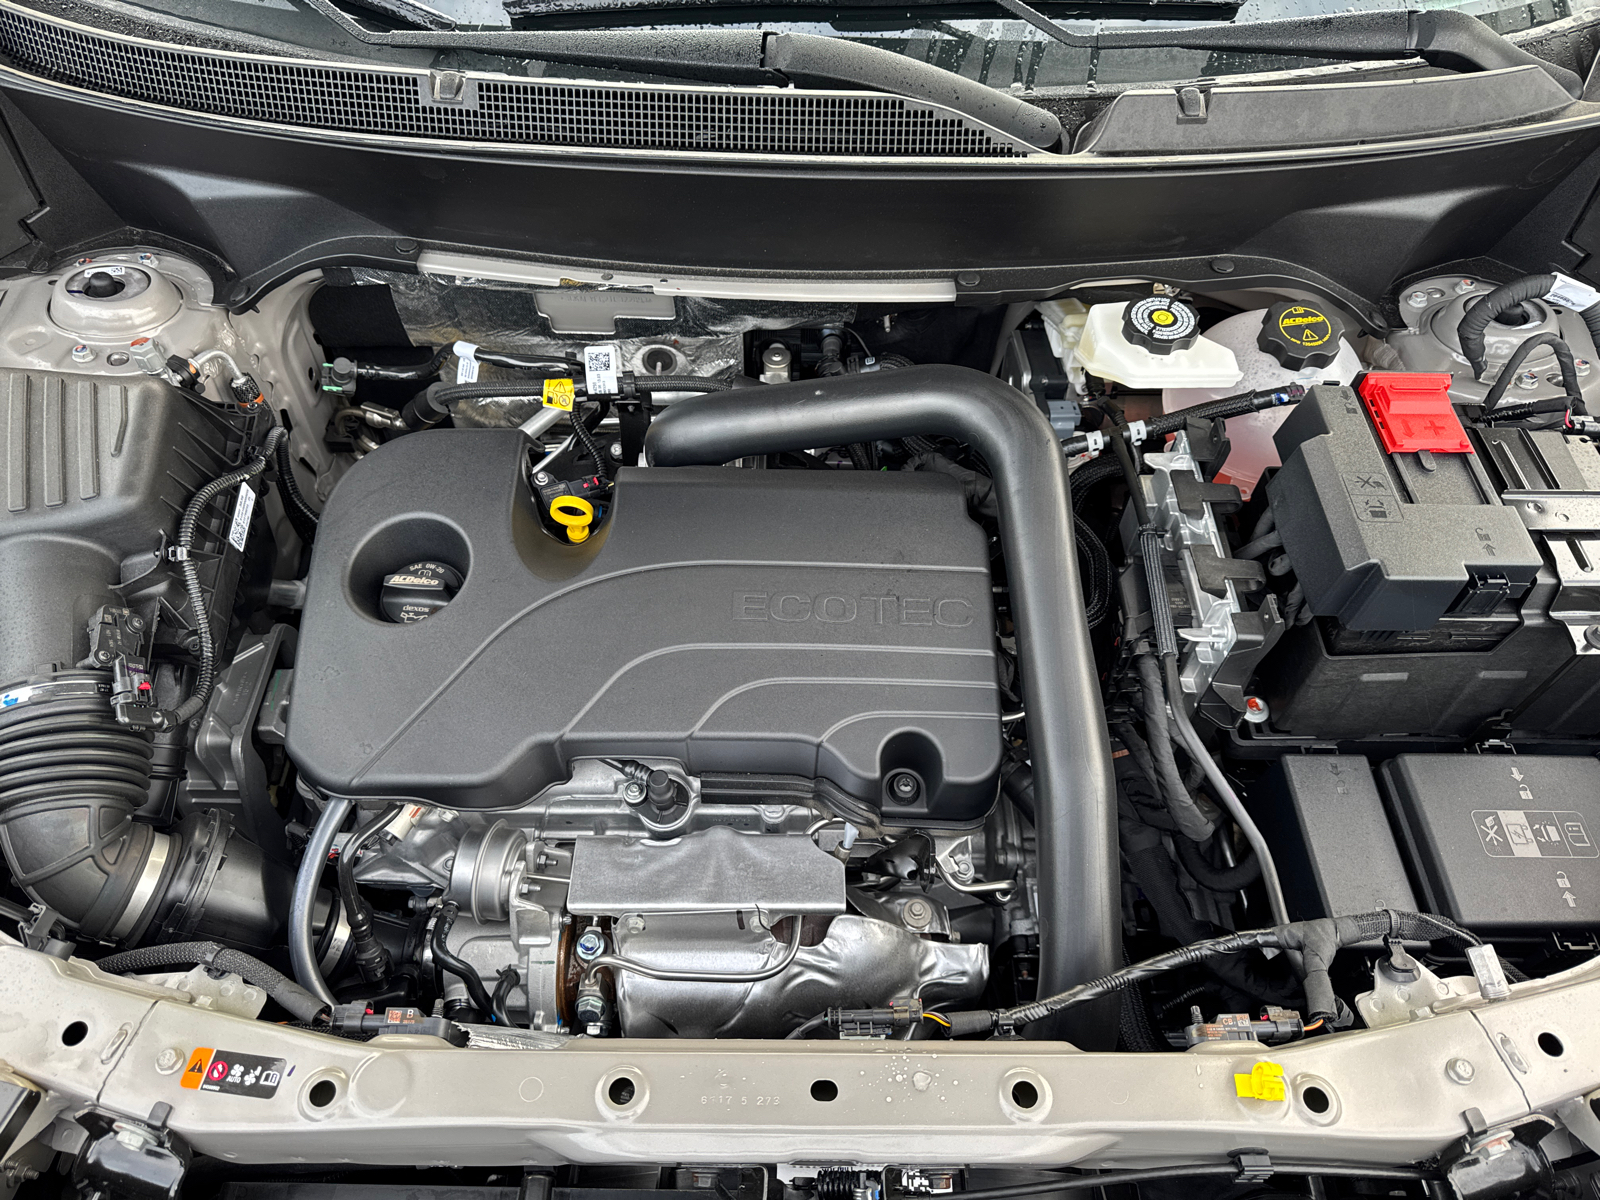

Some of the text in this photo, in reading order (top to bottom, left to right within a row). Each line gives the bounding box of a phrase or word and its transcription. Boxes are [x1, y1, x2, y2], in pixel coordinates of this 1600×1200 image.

[1282, 315, 1324, 326] ACDelco
[409, 563, 445, 574] SAE 0W-20
[389, 575, 439, 585] ACDelco
[403, 604, 430, 612] dexos
[733, 591, 974, 628] ECOTEC
[226, 1075, 241, 1083] AUTO
